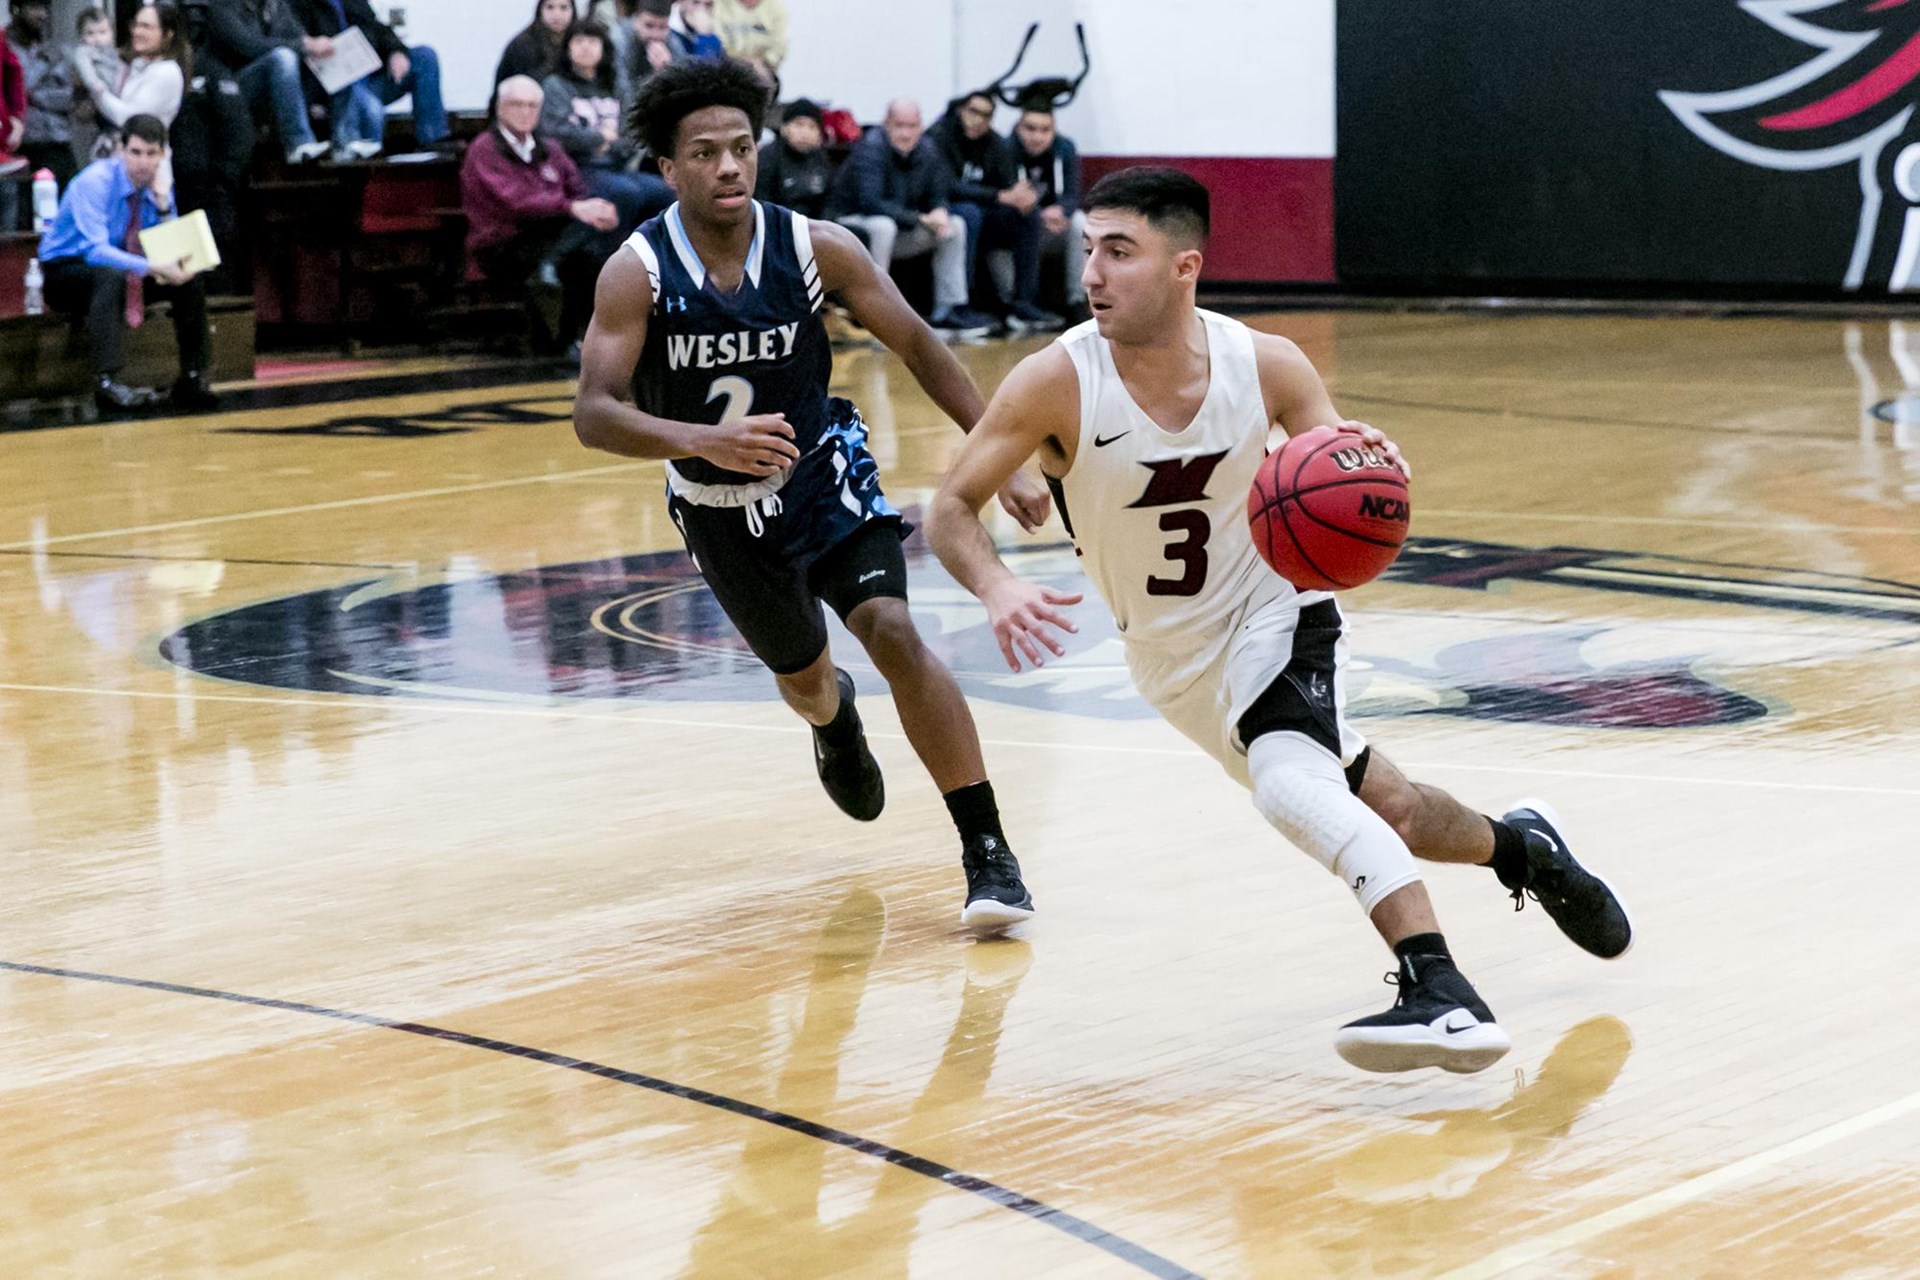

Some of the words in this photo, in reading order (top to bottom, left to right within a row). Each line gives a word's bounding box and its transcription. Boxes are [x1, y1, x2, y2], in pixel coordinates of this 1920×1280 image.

[667, 321, 799, 371] WESLEY
[705, 375, 754, 425] 2
[1358, 493, 1409, 522] NCA
[1147, 509, 1211, 596] 3
